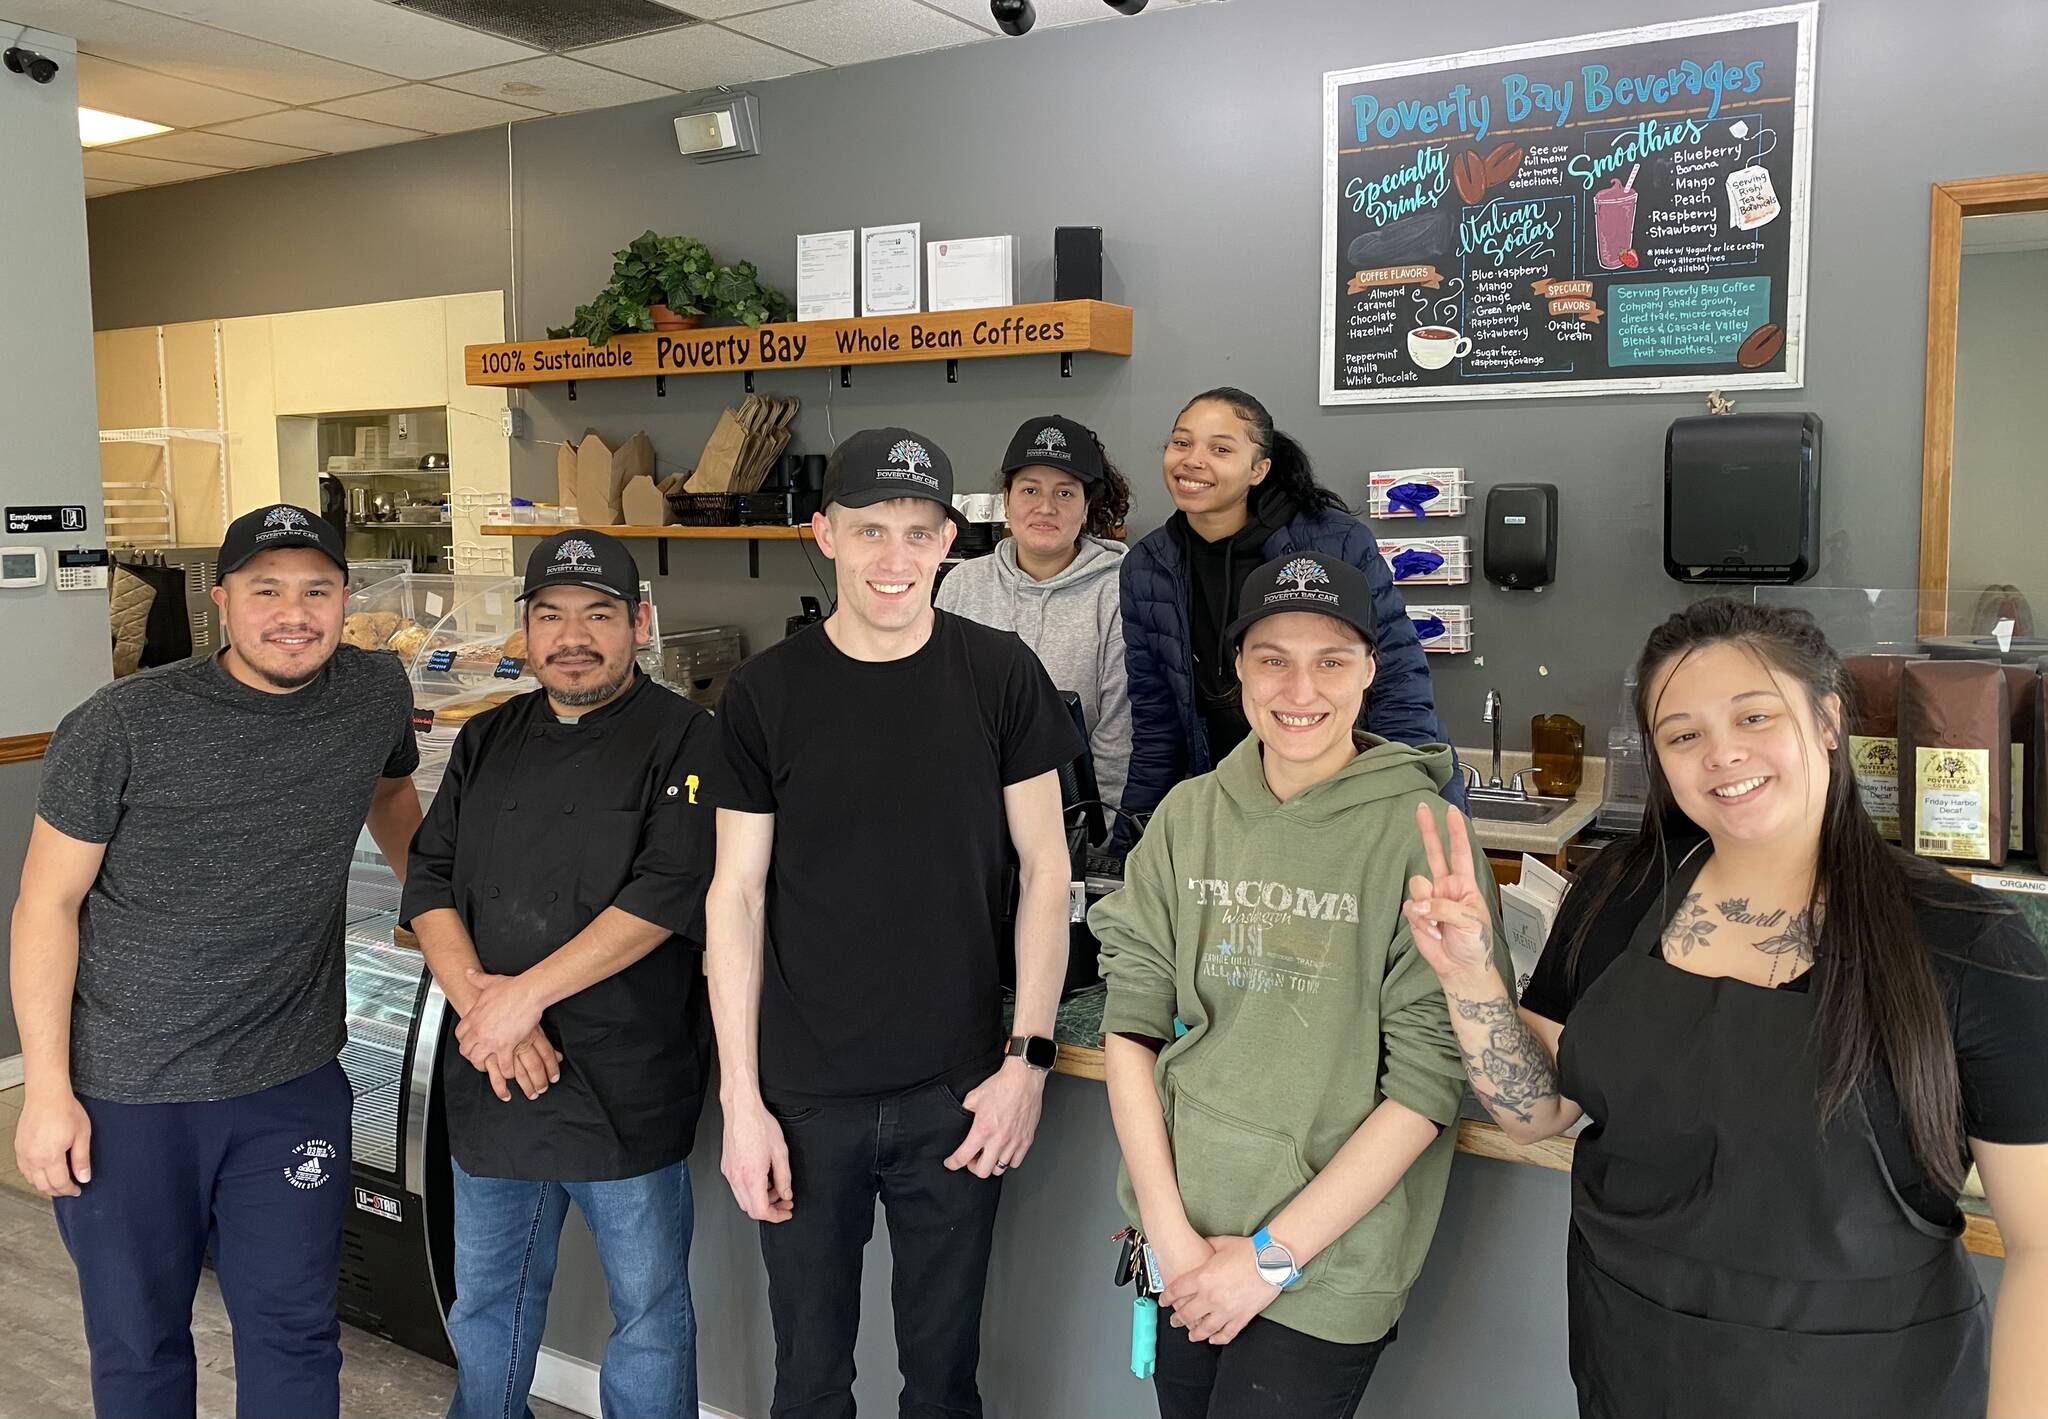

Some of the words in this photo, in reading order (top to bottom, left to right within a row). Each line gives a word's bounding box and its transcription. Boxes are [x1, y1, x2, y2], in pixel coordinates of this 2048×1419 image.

[1351, 84, 1490, 142] Poverty
[1502, 73, 1573, 126] Bay
[1581, 60, 1764, 119] Beverages
[1529, 146, 1549, 156] See
[1552, 145, 1569, 153] our
[1567, 118, 1709, 190] Smoothies
[1673, 144, 1742, 164] Blueberry
[1524, 155, 1539, 166] full
[1540, 155, 1567, 164] menu
[1675, 160, 1719, 175] Banana
[1345, 144, 1450, 214] Specialty
[1517, 167, 1532, 179] for
[1534, 167, 1558, 176] more
[1675, 177, 1716, 192] Mango
[1738, 184, 1763, 196] Rishi
[1366, 179, 1450, 227] Drinks
[1674, 192, 1711, 207] Peach
[1739, 196, 1777, 215] Botanicals
[1741, 195, 1756, 205] Tea
[1652, 207, 1717, 224] Raspberry
[1456, 197, 1546, 257] Italian
[1650, 223, 1718, 238] Strawberry
[1483, 211, 1562, 266] Sodas
[1723, 242, 1736, 252] Ice
[1678, 254, 1726, 264] alternatives
[1360, 270, 1389, 283] COFFEE
[1391, 268, 1428, 280] FLAVORS
[1668, 262, 1711, 274] available)
[1369, 285, 1406, 300] Almond
[1479, 282, 1513, 294] Mango
[1548, 283, 1591, 296] SPECIALTY
[1617, 288, 1660, 301] Serving
[1662, 284, 1699, 299] Poverty
[1701, 284, 1719, 297] Bay
[1722, 282, 1756, 294] Coffee
[1357, 299, 1396, 312] Caramel
[1473, 292, 1511, 305] Orange
[1619, 301, 1663, 313] Company
[1668, 296, 1697, 309] shade
[1700, 297, 1737, 311] grown,
[1476, 305, 1502, 316] Green
[1506, 301, 1532, 314] Apple
[1552, 301, 1591, 312] FLAVORS
[1350, 311, 1397, 326] Chocolate
[1471, 314, 1519, 330] Raspberry
[1621, 313, 1648, 325] direct
[1650, 310, 1678, 321] trade,
[1680, 306, 1750, 319] micro-roasted
[1350, 323, 1394, 339] Hazelnut
[1548, 320, 1587, 332] Orange
[1618, 324, 1655, 336] coffees
[1657, 322, 1665, 332] &
[1667, 320, 1712, 333] Cascade
[1715, 320, 1749, 332] Valley
[1476, 327, 1529, 341] Strawberry
[1557, 331, 1592, 342] Cream
[1622, 336, 1657, 348] Blends
[1660, 334, 1672, 346] all
[1675, 332, 1717, 345] natural,
[1719, 332, 1742, 343] real
[481, 350, 526, 374] 100%
[532, 343, 633, 371] Sustainable
[656, 334, 750, 369] Poverty
[759, 329, 807, 363] Bay
[835, 326, 900, 354] Whole
[911, 324, 962, 349] Bean
[973, 316, 1065, 346] Coffees
[1500, 345, 1521, 357] free:
[1633, 348, 1655, 359] fruit
[1657, 345, 1717, 357] smoothies.
[1346, 348, 1399, 364] Peppermint
[1347, 363, 1378, 375] Vanilla
[1346, 375, 1372, 386] White
[1376, 371, 1419, 384] Chocolate
[9, 513, 53, 522] Employees
[10, 522, 29, 531] Only
[1264, 592, 1300, 602] POVERTY
[1925, 797, 1949, 807] Friday
[1950, 799, 1978, 807] Harbor
[1939, 807, 1963, 815] Decaf
[1999, 879, 2046, 891] ORGANIC
[1187, 876, 1360, 924] TACOMA
[359, 1191, 398, 1214] U-STAR
